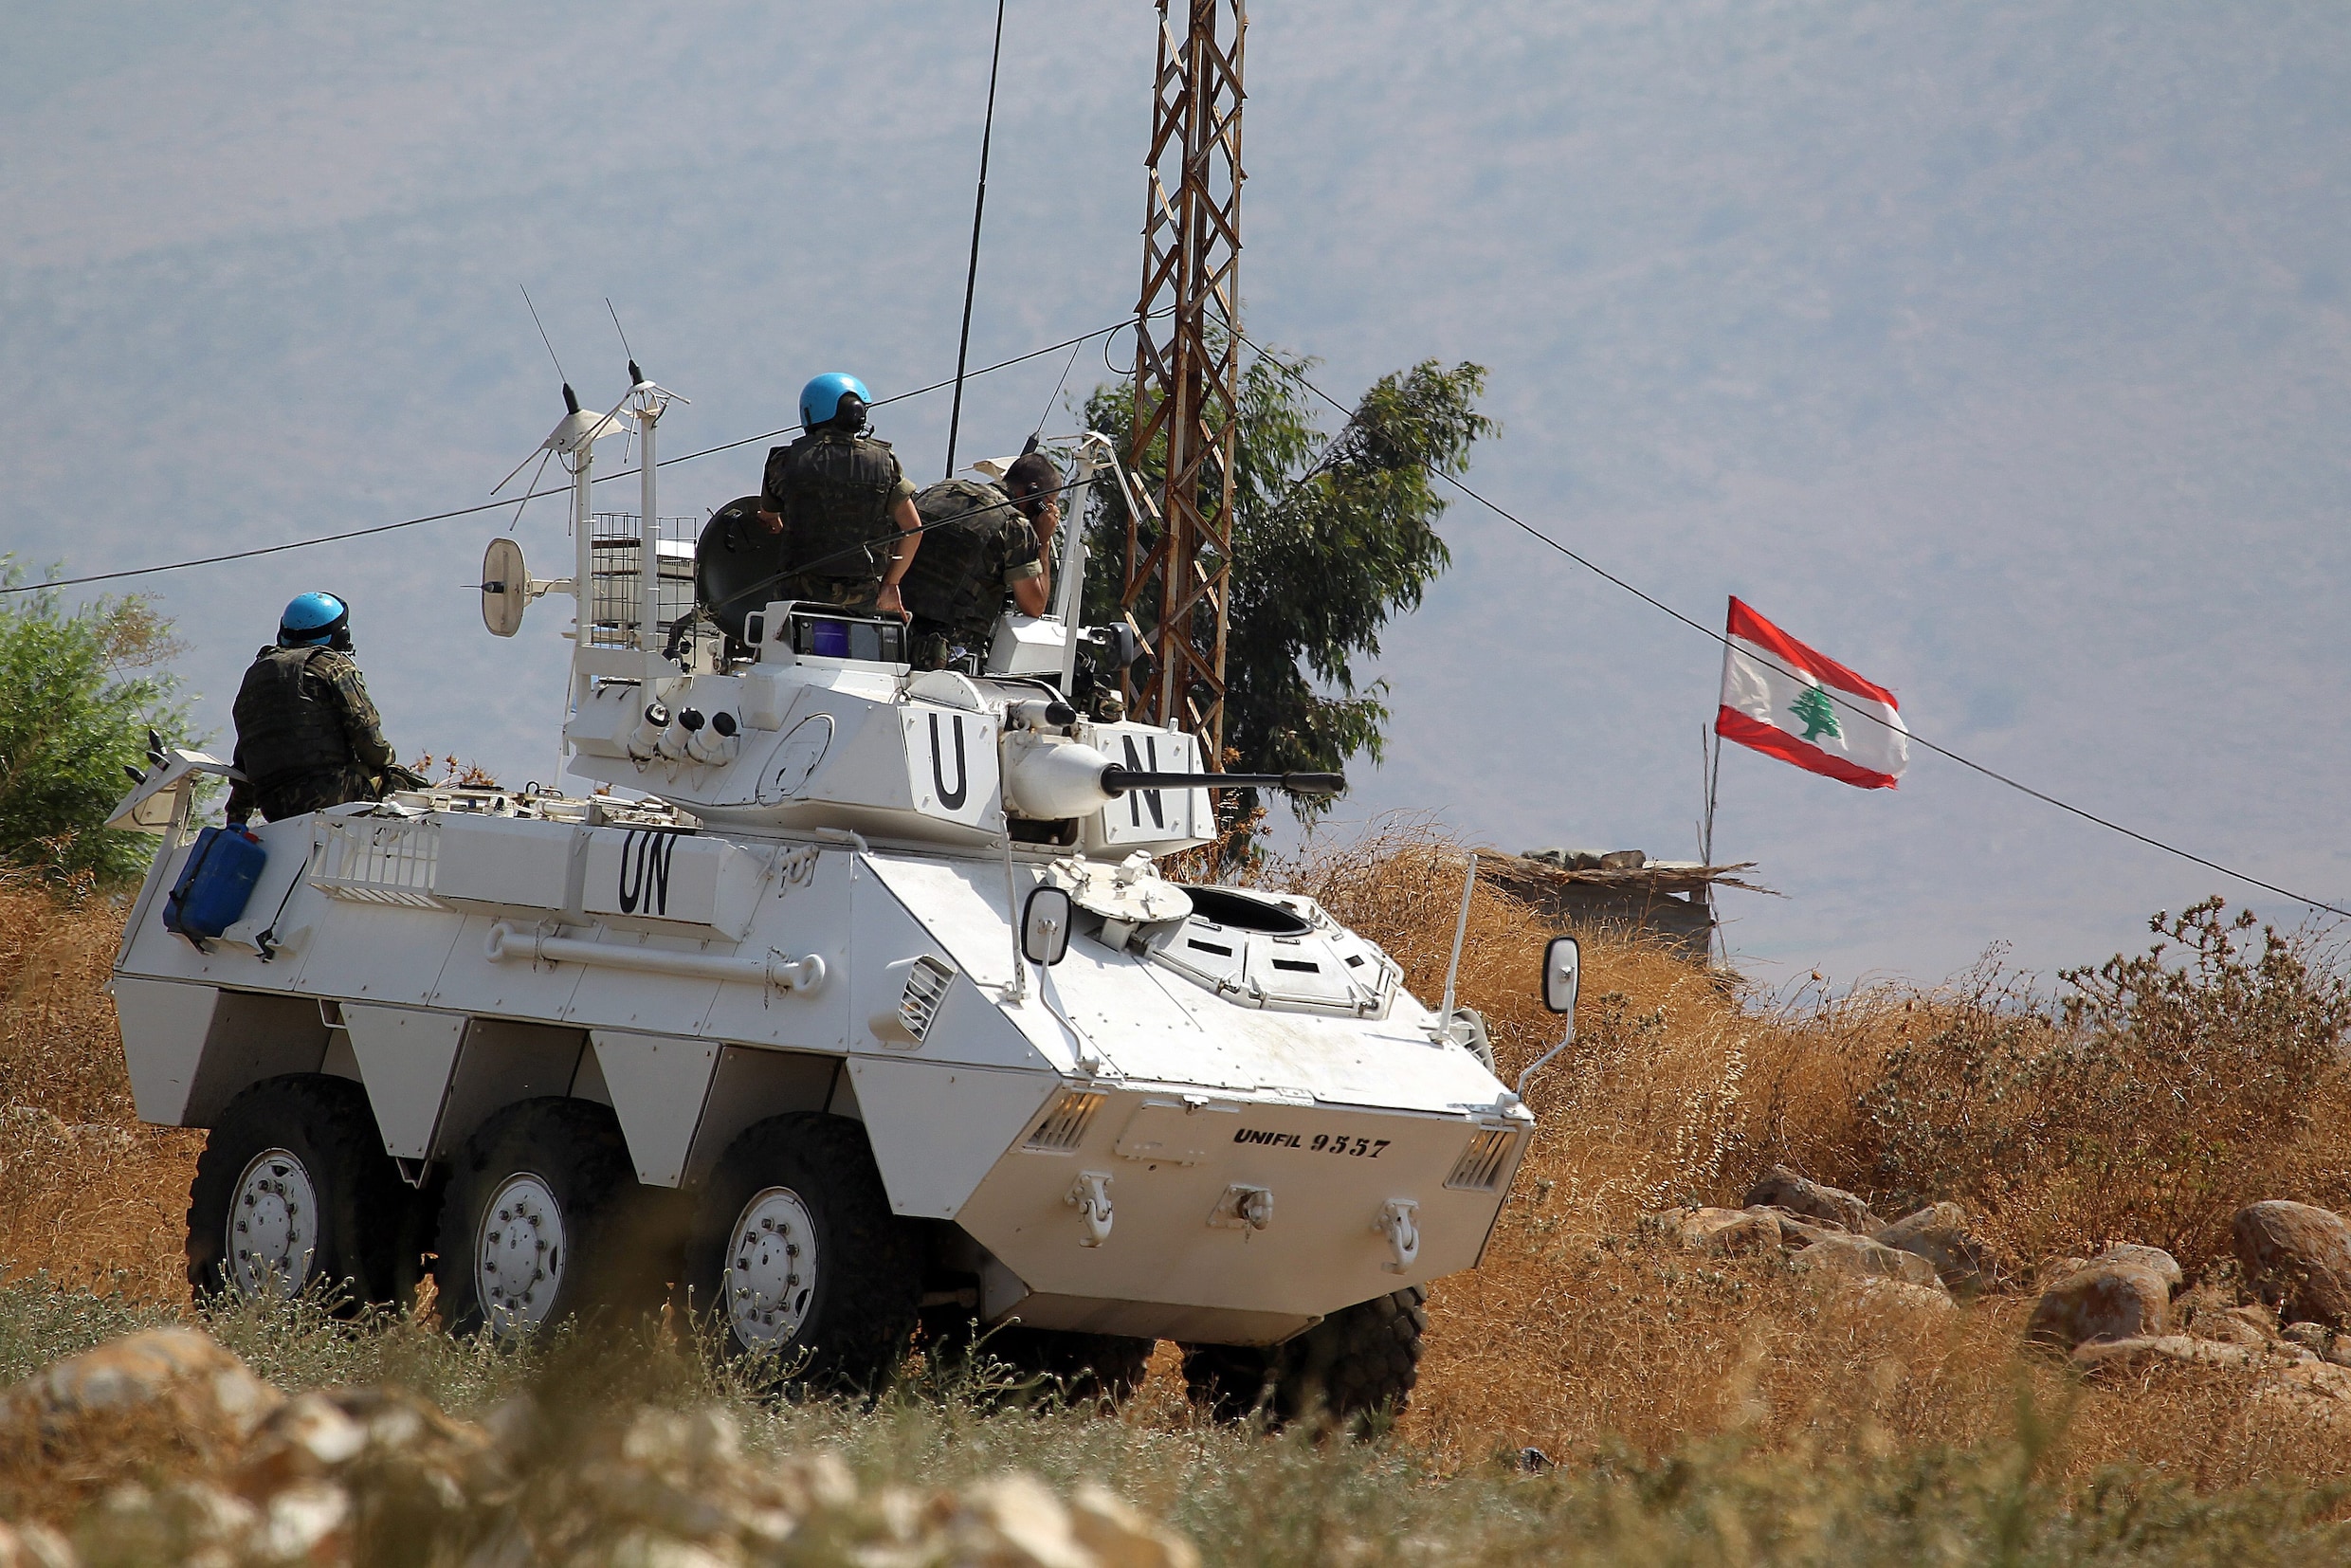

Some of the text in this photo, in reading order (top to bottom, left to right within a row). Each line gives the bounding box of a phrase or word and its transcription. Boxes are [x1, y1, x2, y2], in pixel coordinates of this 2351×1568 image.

[619, 830, 678, 916] UN
[1233, 1128, 1392, 1158] UNIFIL 9557
